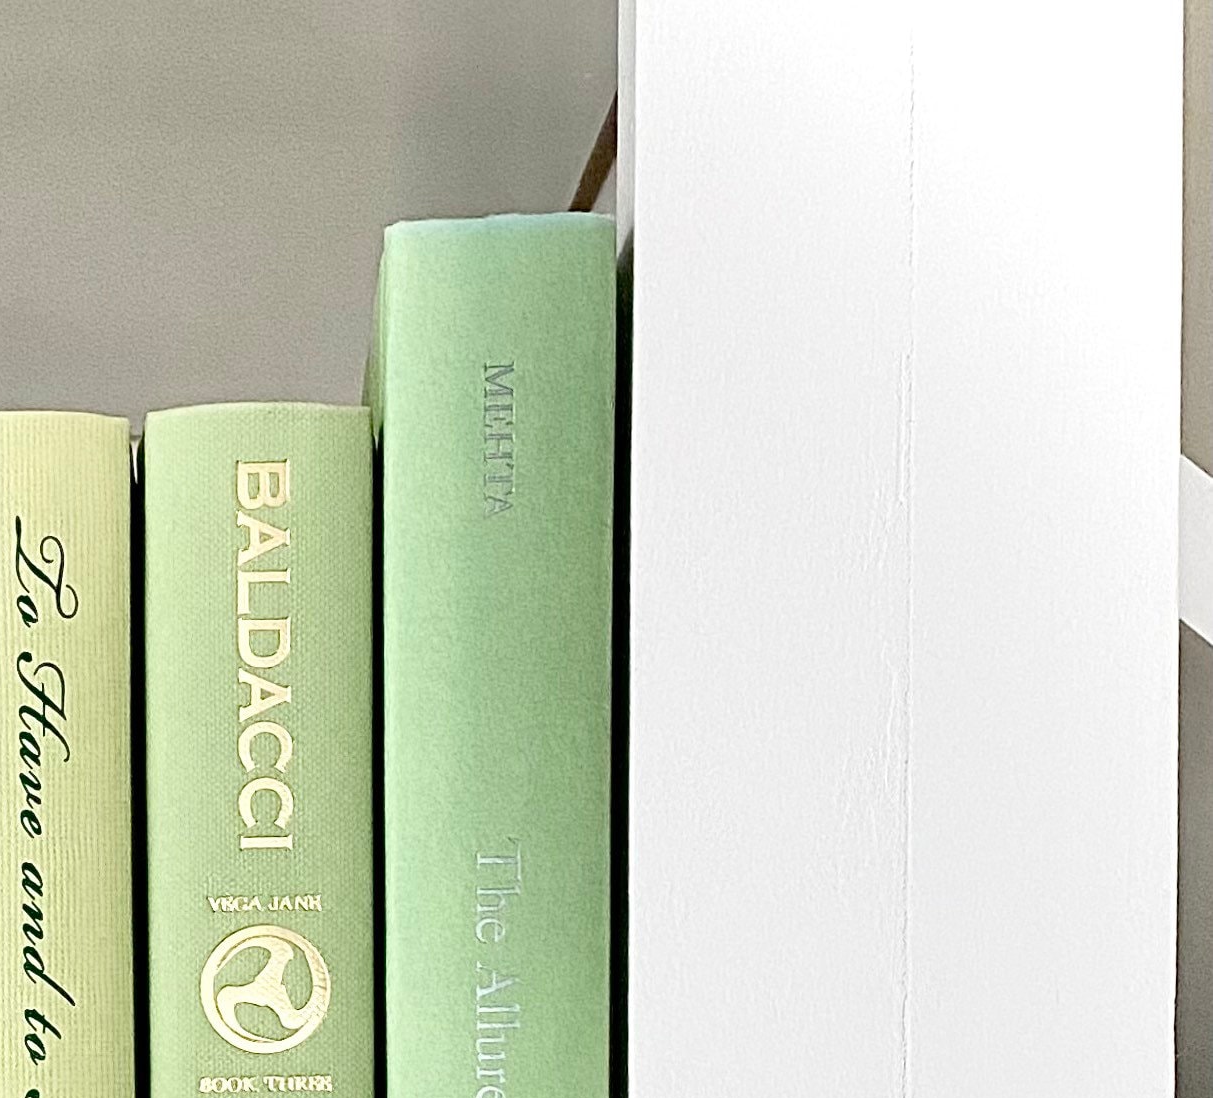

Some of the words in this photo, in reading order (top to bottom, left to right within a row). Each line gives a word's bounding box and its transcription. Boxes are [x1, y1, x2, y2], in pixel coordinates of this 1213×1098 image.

[483, 361, 516, 519] MEHTA
[15, 515, 79, 629] To
[235, 460, 294, 851] BALDACCI
[16, 652, 70, 837] Have
[20, 861, 76, 1007] and
[475, 836, 522, 944] The
[21, 1010, 63, 1067] to
[199, 1076, 259, 1094] BOOK
